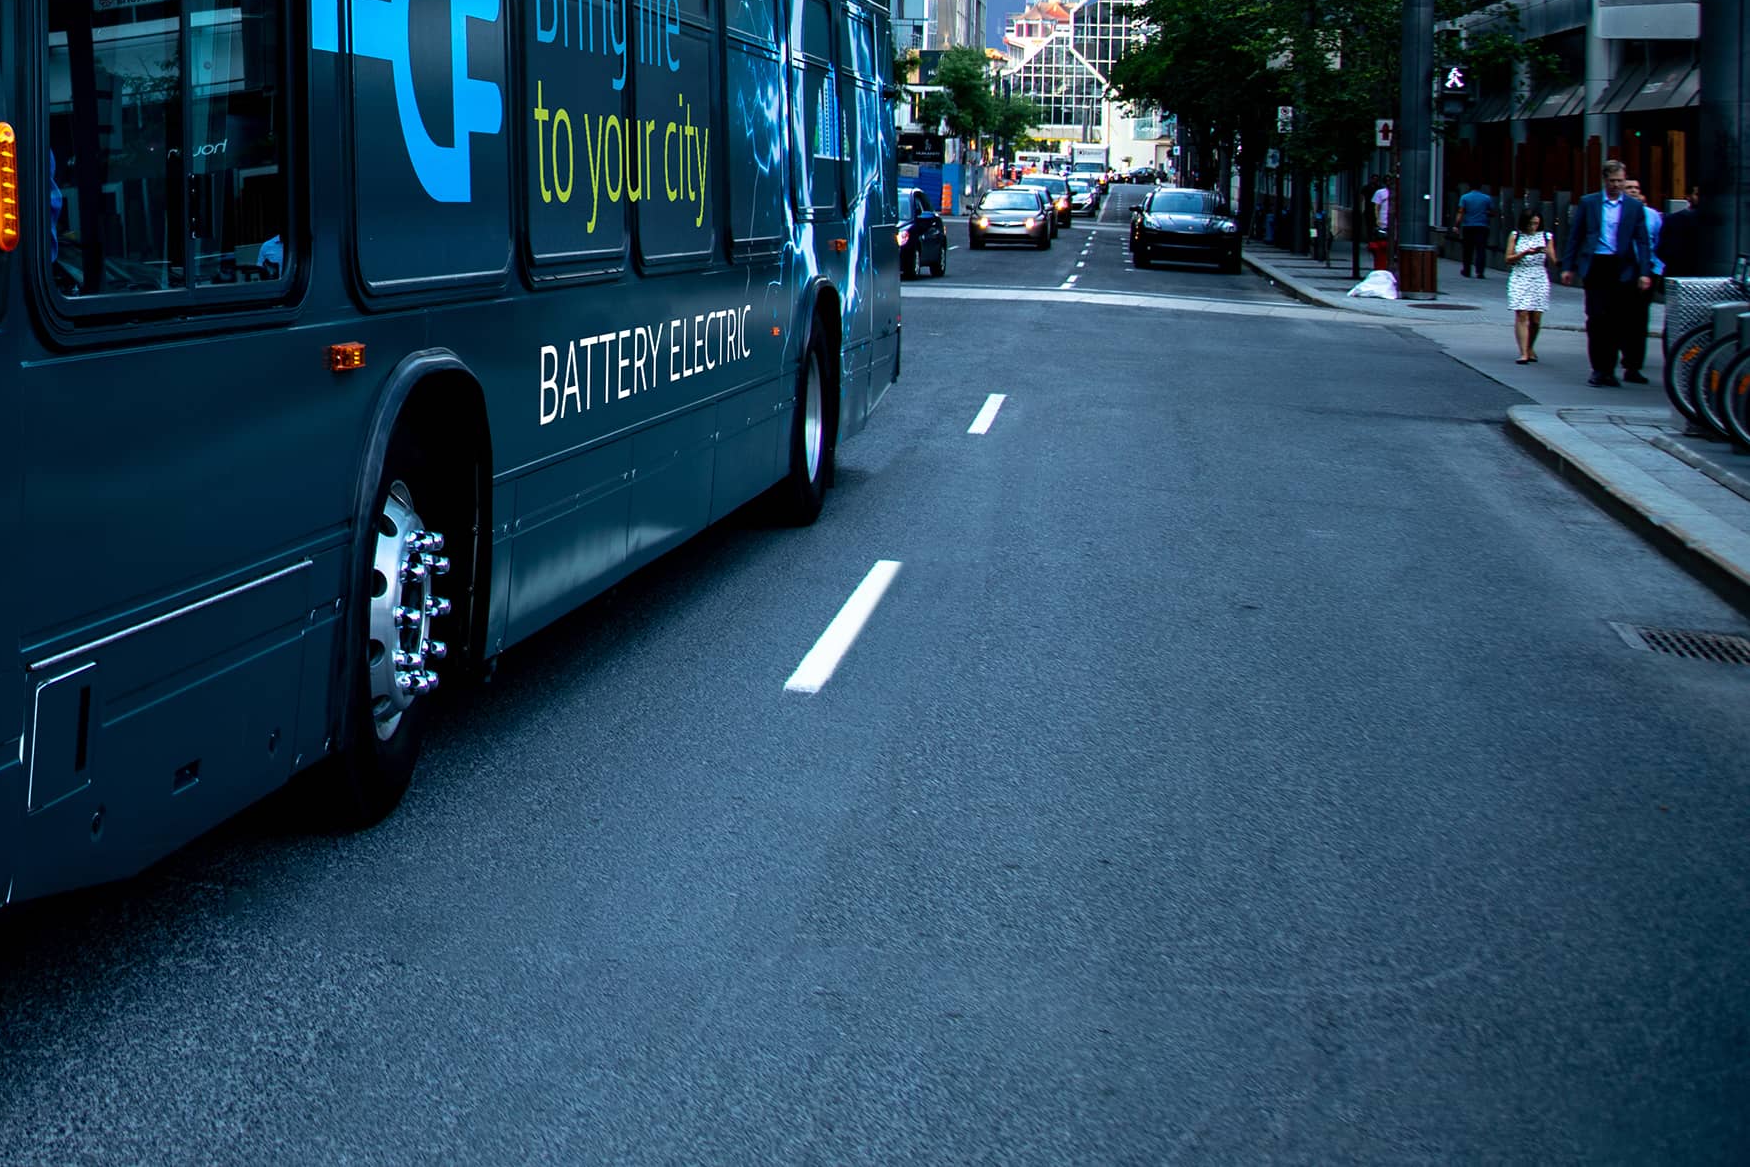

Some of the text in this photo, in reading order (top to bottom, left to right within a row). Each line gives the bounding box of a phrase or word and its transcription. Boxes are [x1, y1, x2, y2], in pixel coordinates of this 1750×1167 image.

[534, 80, 709, 234] to your city
[539, 304, 752, 426] BATTERY ELECTRIC
